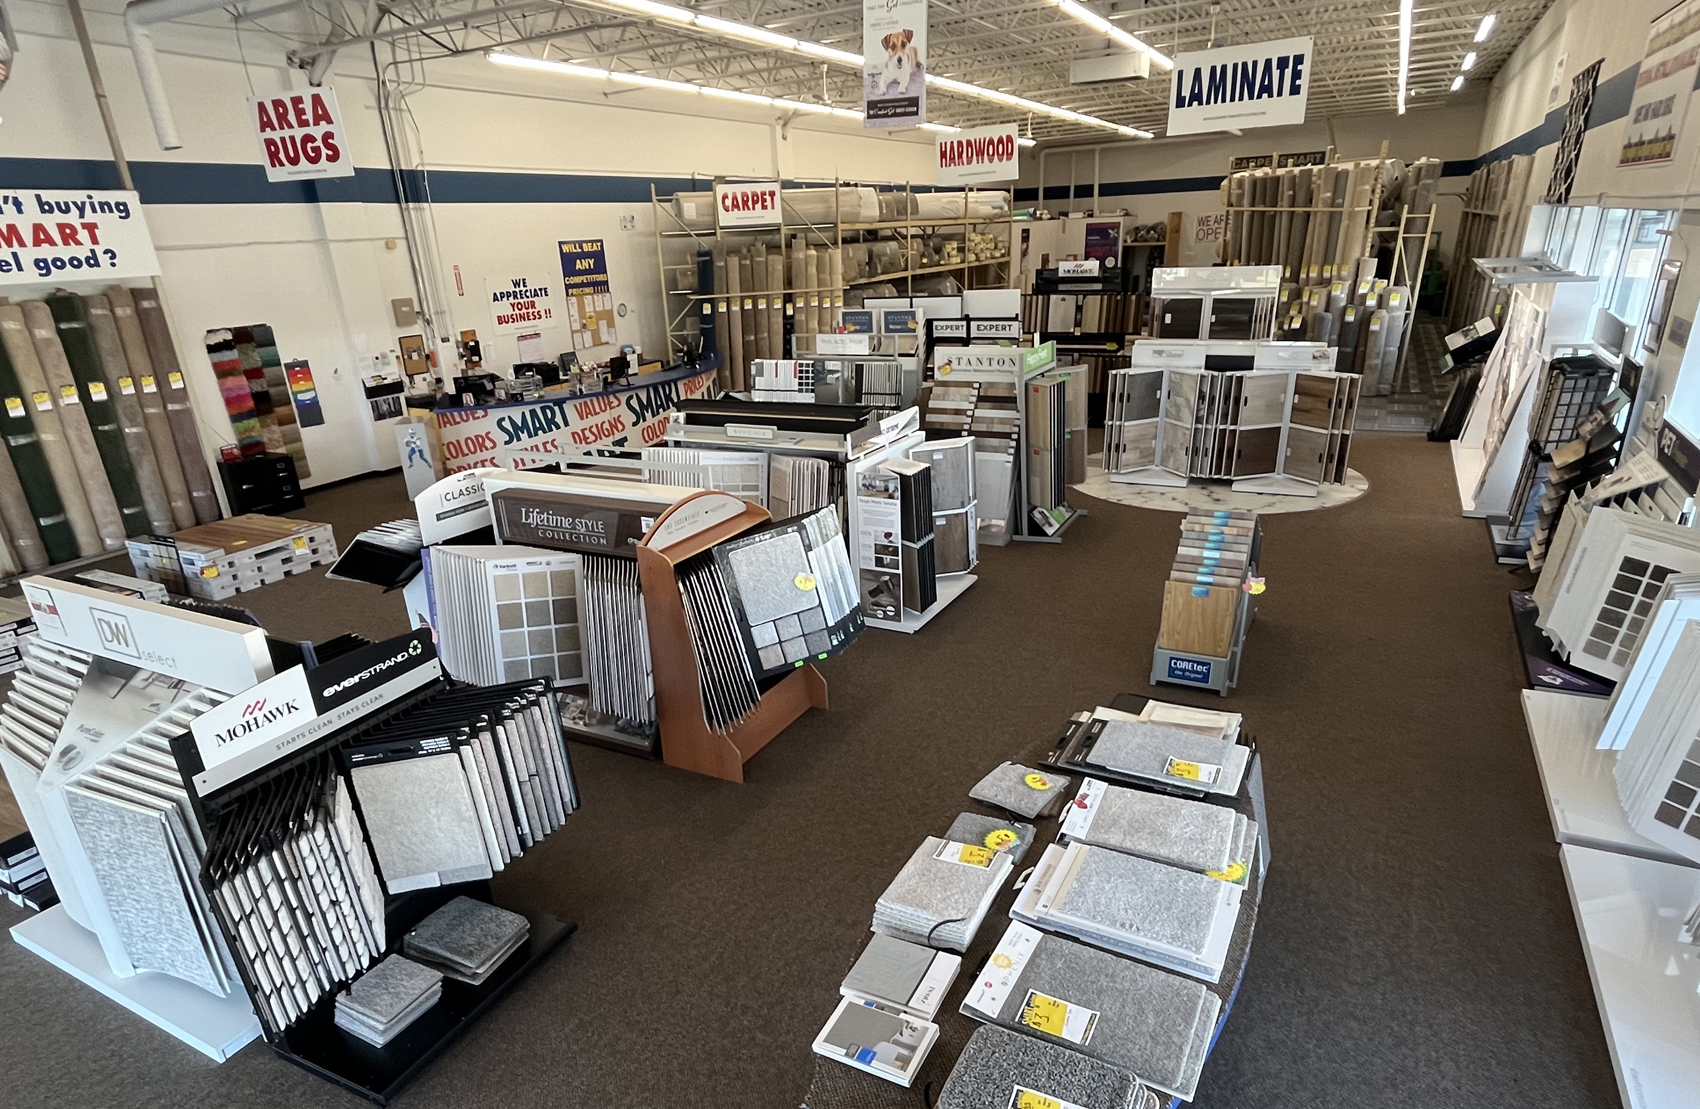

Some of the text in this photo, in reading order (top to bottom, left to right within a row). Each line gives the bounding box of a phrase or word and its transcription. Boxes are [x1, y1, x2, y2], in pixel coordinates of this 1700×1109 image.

[1175, 53, 1305, 109] LAMINATE
[257, 93, 334, 133] AREA
[263, 131, 341, 168] RUGS
[939, 134, 1014, 168] HARDWOOD
[34, 193, 131, 220] buying
[721, 189, 776, 212] CARPET
[1197, 215, 1212, 227] WE
[561, 242, 602, 253] WILL BEAT
[575, 258, 595, 270] ANY
[511, 278, 528, 288] WE
[564, 273, 608, 285] COMPETITORS
[492, 287, 549, 303] APPRECIATE
[568, 286, 594, 296] PRICING
[496, 310, 543, 325] BUSINESS
[509, 300, 537, 312] YOUR
[934, 324, 965, 332] EXPERT
[976, 323, 1013, 332] EXPERT
[573, 394, 622, 421] VALUES
[496, 400, 571, 446] SMART
[571, 415, 626, 446] DESIGNS
[443, 431, 498, 462] OLORS
[521, 507, 605, 533] Lifetime STYLE
[538, 528, 608, 546] COLLECTION
[97, 617, 130, 648] DW
[142, 649, 178, 669] select
[1171, 659, 1211, 674] COREtec
[322, 651, 408, 698] everSTRAND
[214, 698, 300, 748] MOHAWK
[275, 731, 307, 751] STARTS
[337, 703, 361, 722] STAYS
[361, 692, 384, 709] CLEAN
